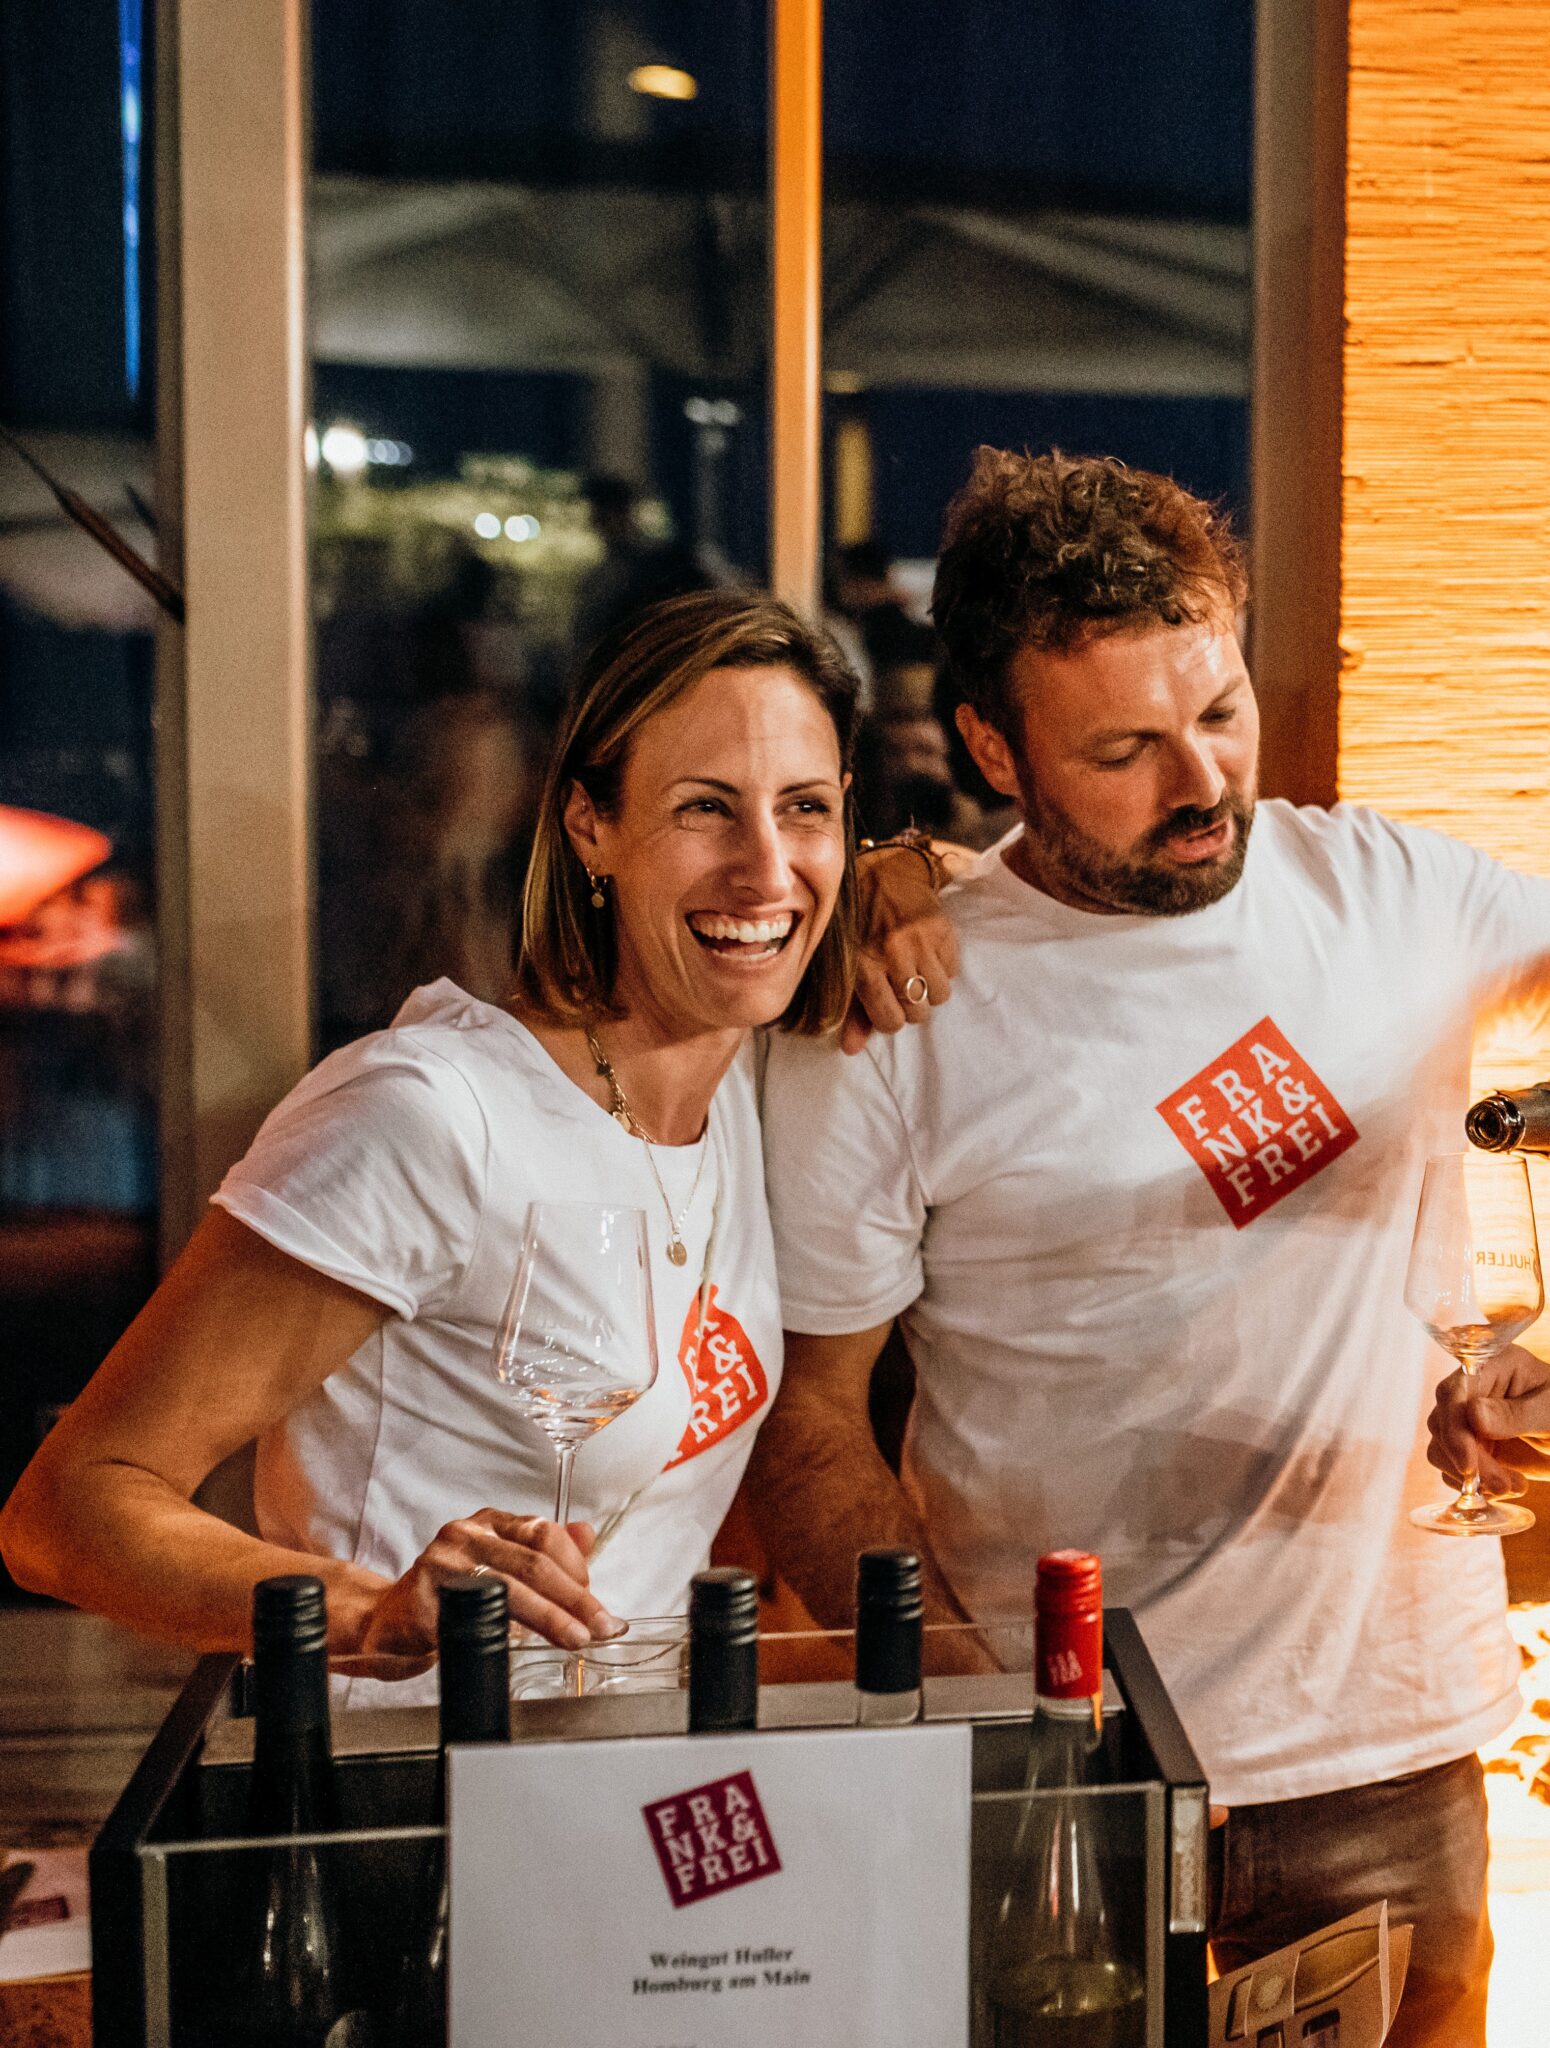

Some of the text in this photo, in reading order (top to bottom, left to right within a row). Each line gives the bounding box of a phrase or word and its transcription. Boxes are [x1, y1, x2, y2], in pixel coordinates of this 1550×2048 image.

[1176, 1042, 1291, 1140] FRA
[1202, 1075, 1316, 1173] NK&
[1226, 1102, 1341, 1208] FREI
[669, 1364, 758, 1461] REI
[655, 1784, 750, 1838] FRA
[664, 1812, 760, 1866] NK&
[674, 1837, 769, 1895] FREI
[632, 1970, 810, 1994] Homburg am Main
[650, 1952, 728, 1970] Weingut
